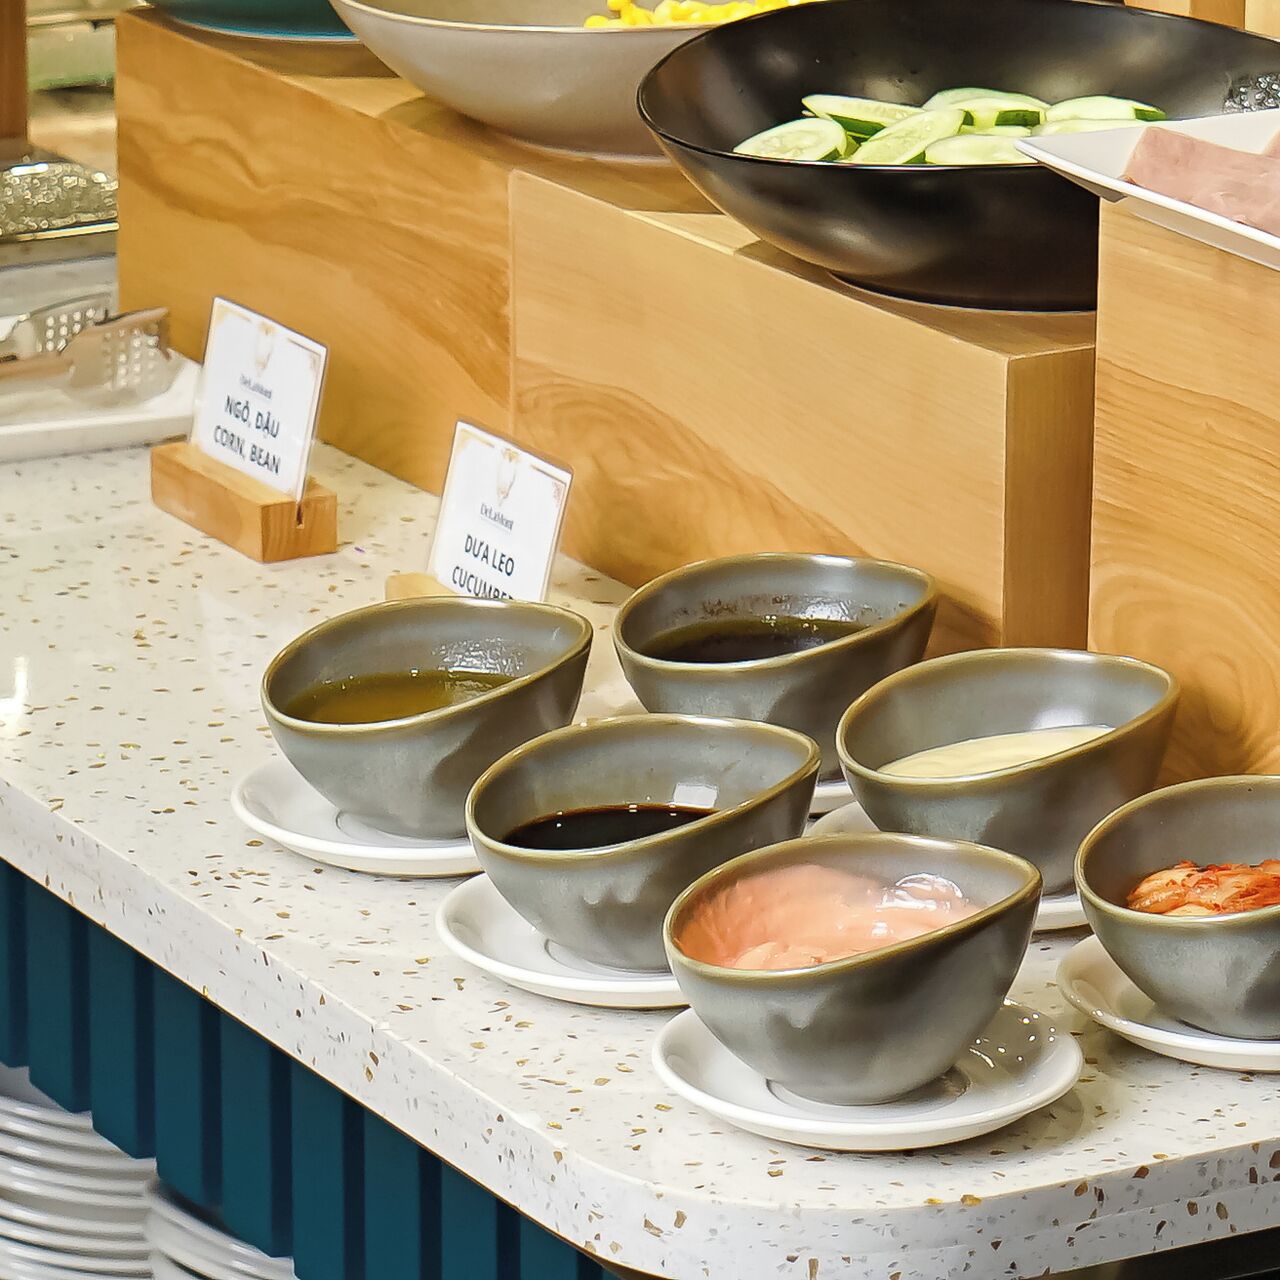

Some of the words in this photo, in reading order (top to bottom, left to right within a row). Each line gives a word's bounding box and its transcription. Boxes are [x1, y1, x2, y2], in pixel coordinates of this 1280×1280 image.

[250, 444, 281, 474] BEAN
[464, 534, 489, 564] DƯA
[492, 548, 515, 576] LEO
